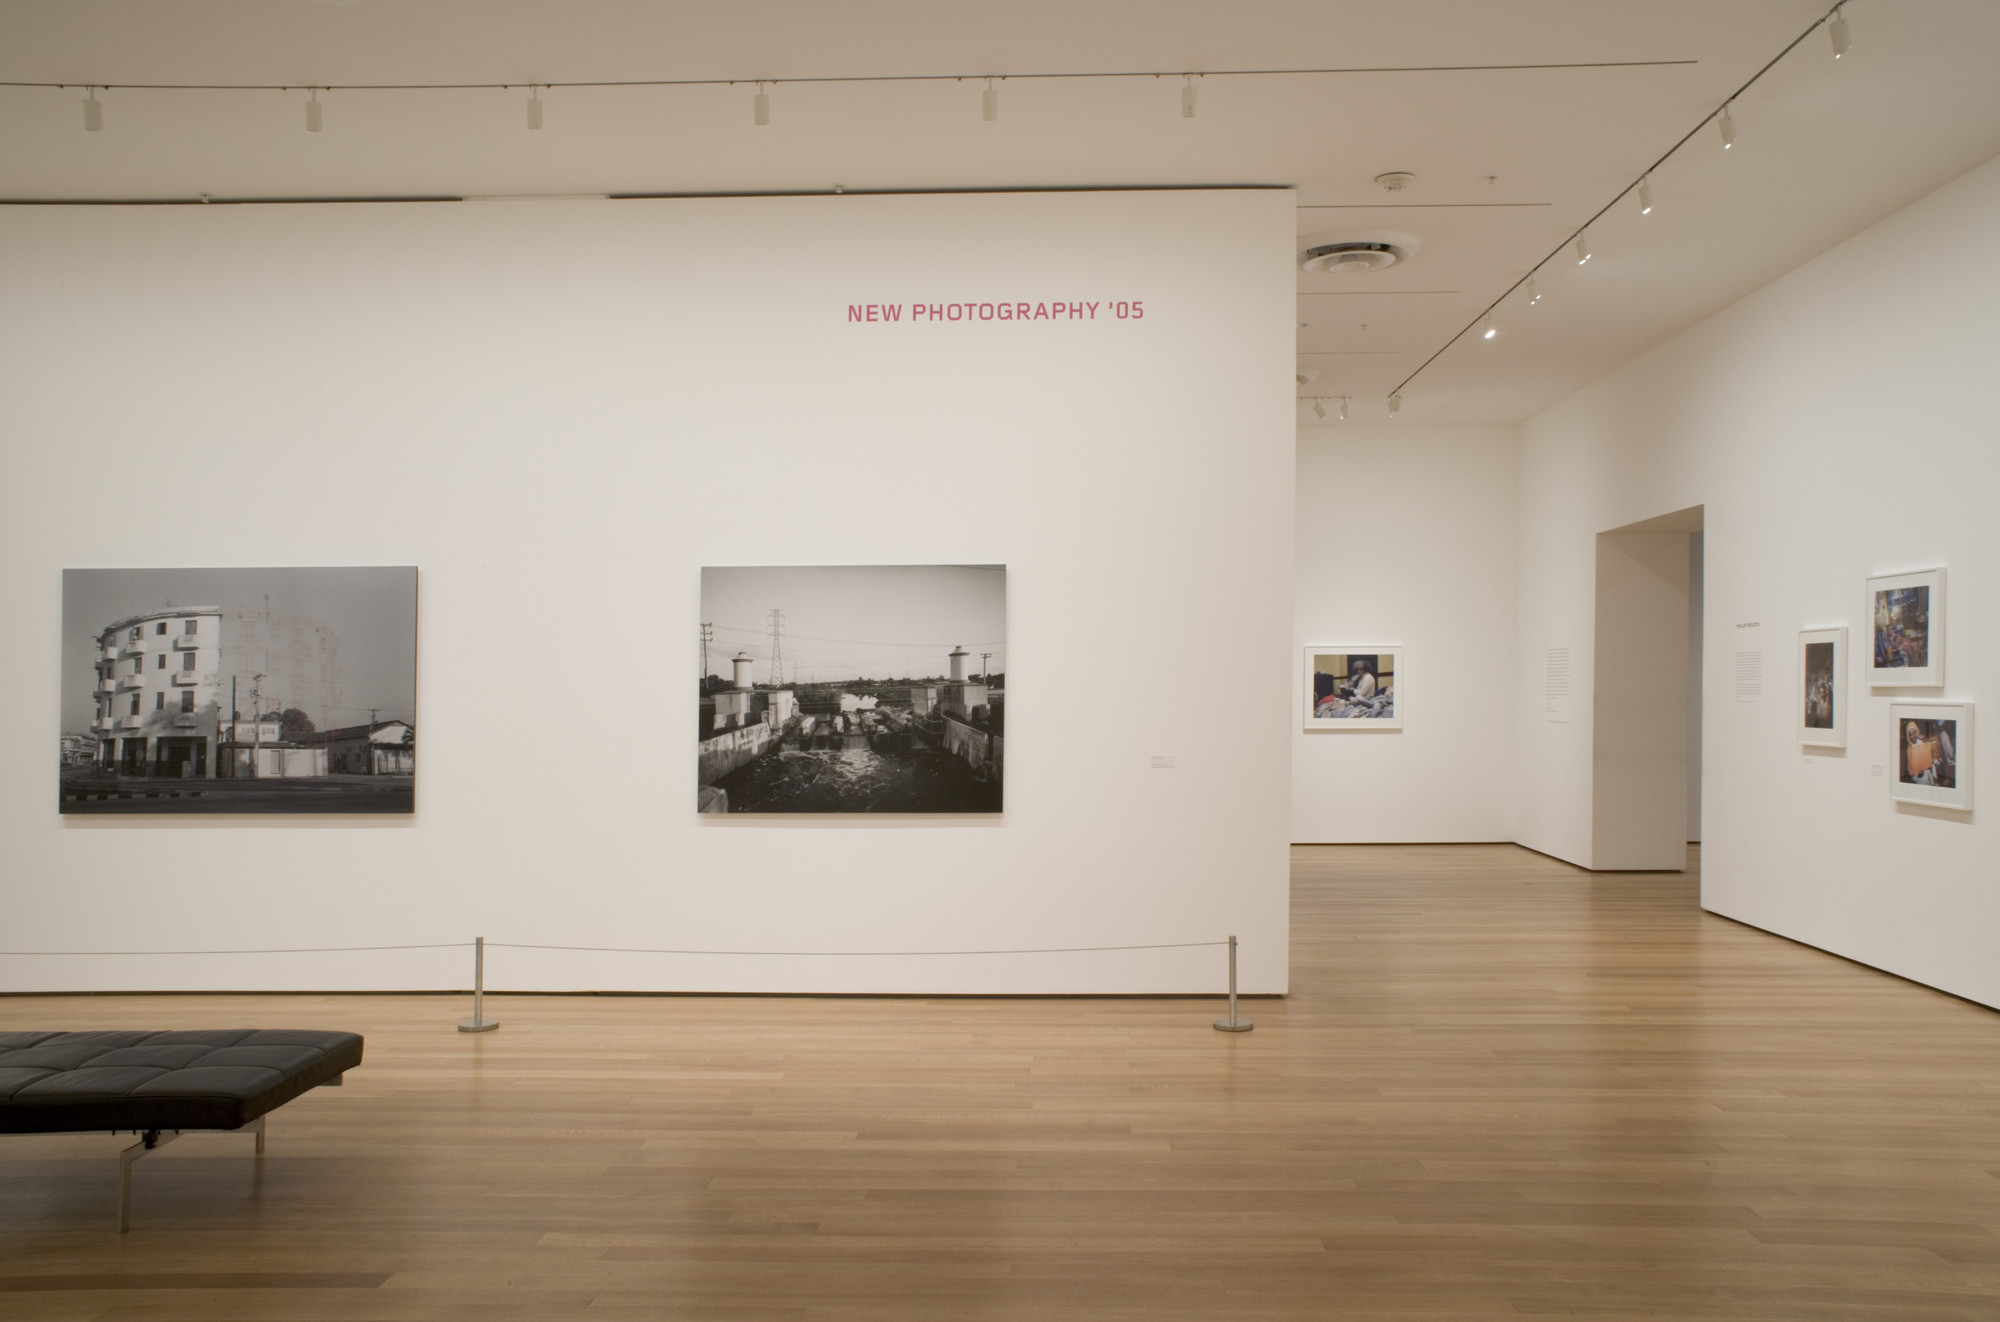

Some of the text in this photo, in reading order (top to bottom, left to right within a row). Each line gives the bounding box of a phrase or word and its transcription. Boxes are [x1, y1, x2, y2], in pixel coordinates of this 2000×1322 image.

[847, 300, 1144, 323] NEW PHOTOGRAPHY '05
